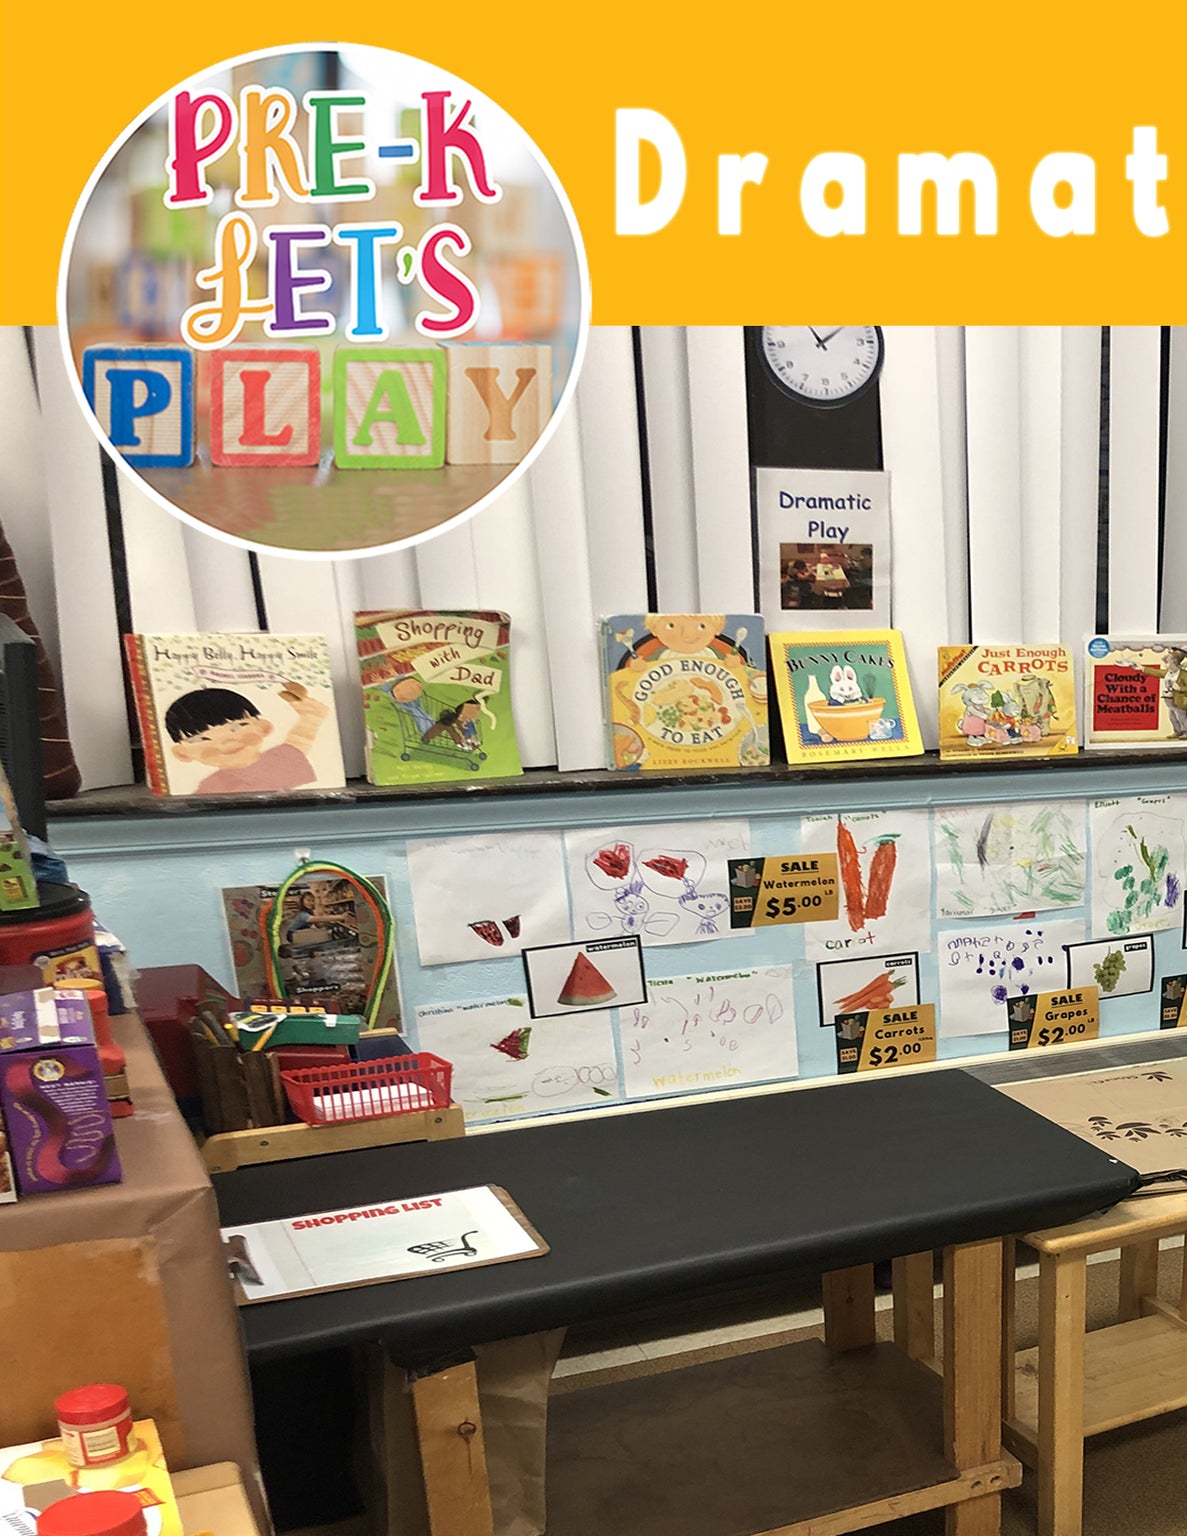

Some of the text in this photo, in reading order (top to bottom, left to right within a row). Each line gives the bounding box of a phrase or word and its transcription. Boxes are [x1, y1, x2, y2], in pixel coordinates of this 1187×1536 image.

[778, 490, 872, 511] Dramatic
[807, 520, 850, 544] Play
[395, 620, 485, 648] Shopping
[430, 648, 461, 669] with
[785, 649, 895, 673] BUNNY CAKES
[981, 647, 1067, 659] Just Enough
[977, 659, 1069, 677] CARROTS
[450, 666, 495, 687] Dad
[634, 659, 745, 703] GOOD ENOUGH
[1104, 673, 1148, 684] Cloudy
[1105, 684, 1147, 694] With a
[1097, 694, 1156, 704] Chance of
[1097, 704, 1155, 714] Meatballs
[661, 727, 684, 743] TO
[691, 726, 726, 745] EAT
[781, 860, 819, 873] SALE
[763, 877, 835, 890] Watermelon
[765, 895, 822, 919] $5.00
[587, 940, 637, 952] watermelon
[1124, 941, 1148, 952] grapes
[1050, 993, 1083, 1006] SALE
[883, 1011, 918, 1024] SALE
[1045, 1008, 1088, 1022] Grapes
[874, 1025, 925, 1040] Carrots
[1037, 1023, 1086, 1046] $2.00
[868, 1042, 922, 1067] $2.00
[292, 1198, 443, 1230] SHOPPING LIST
